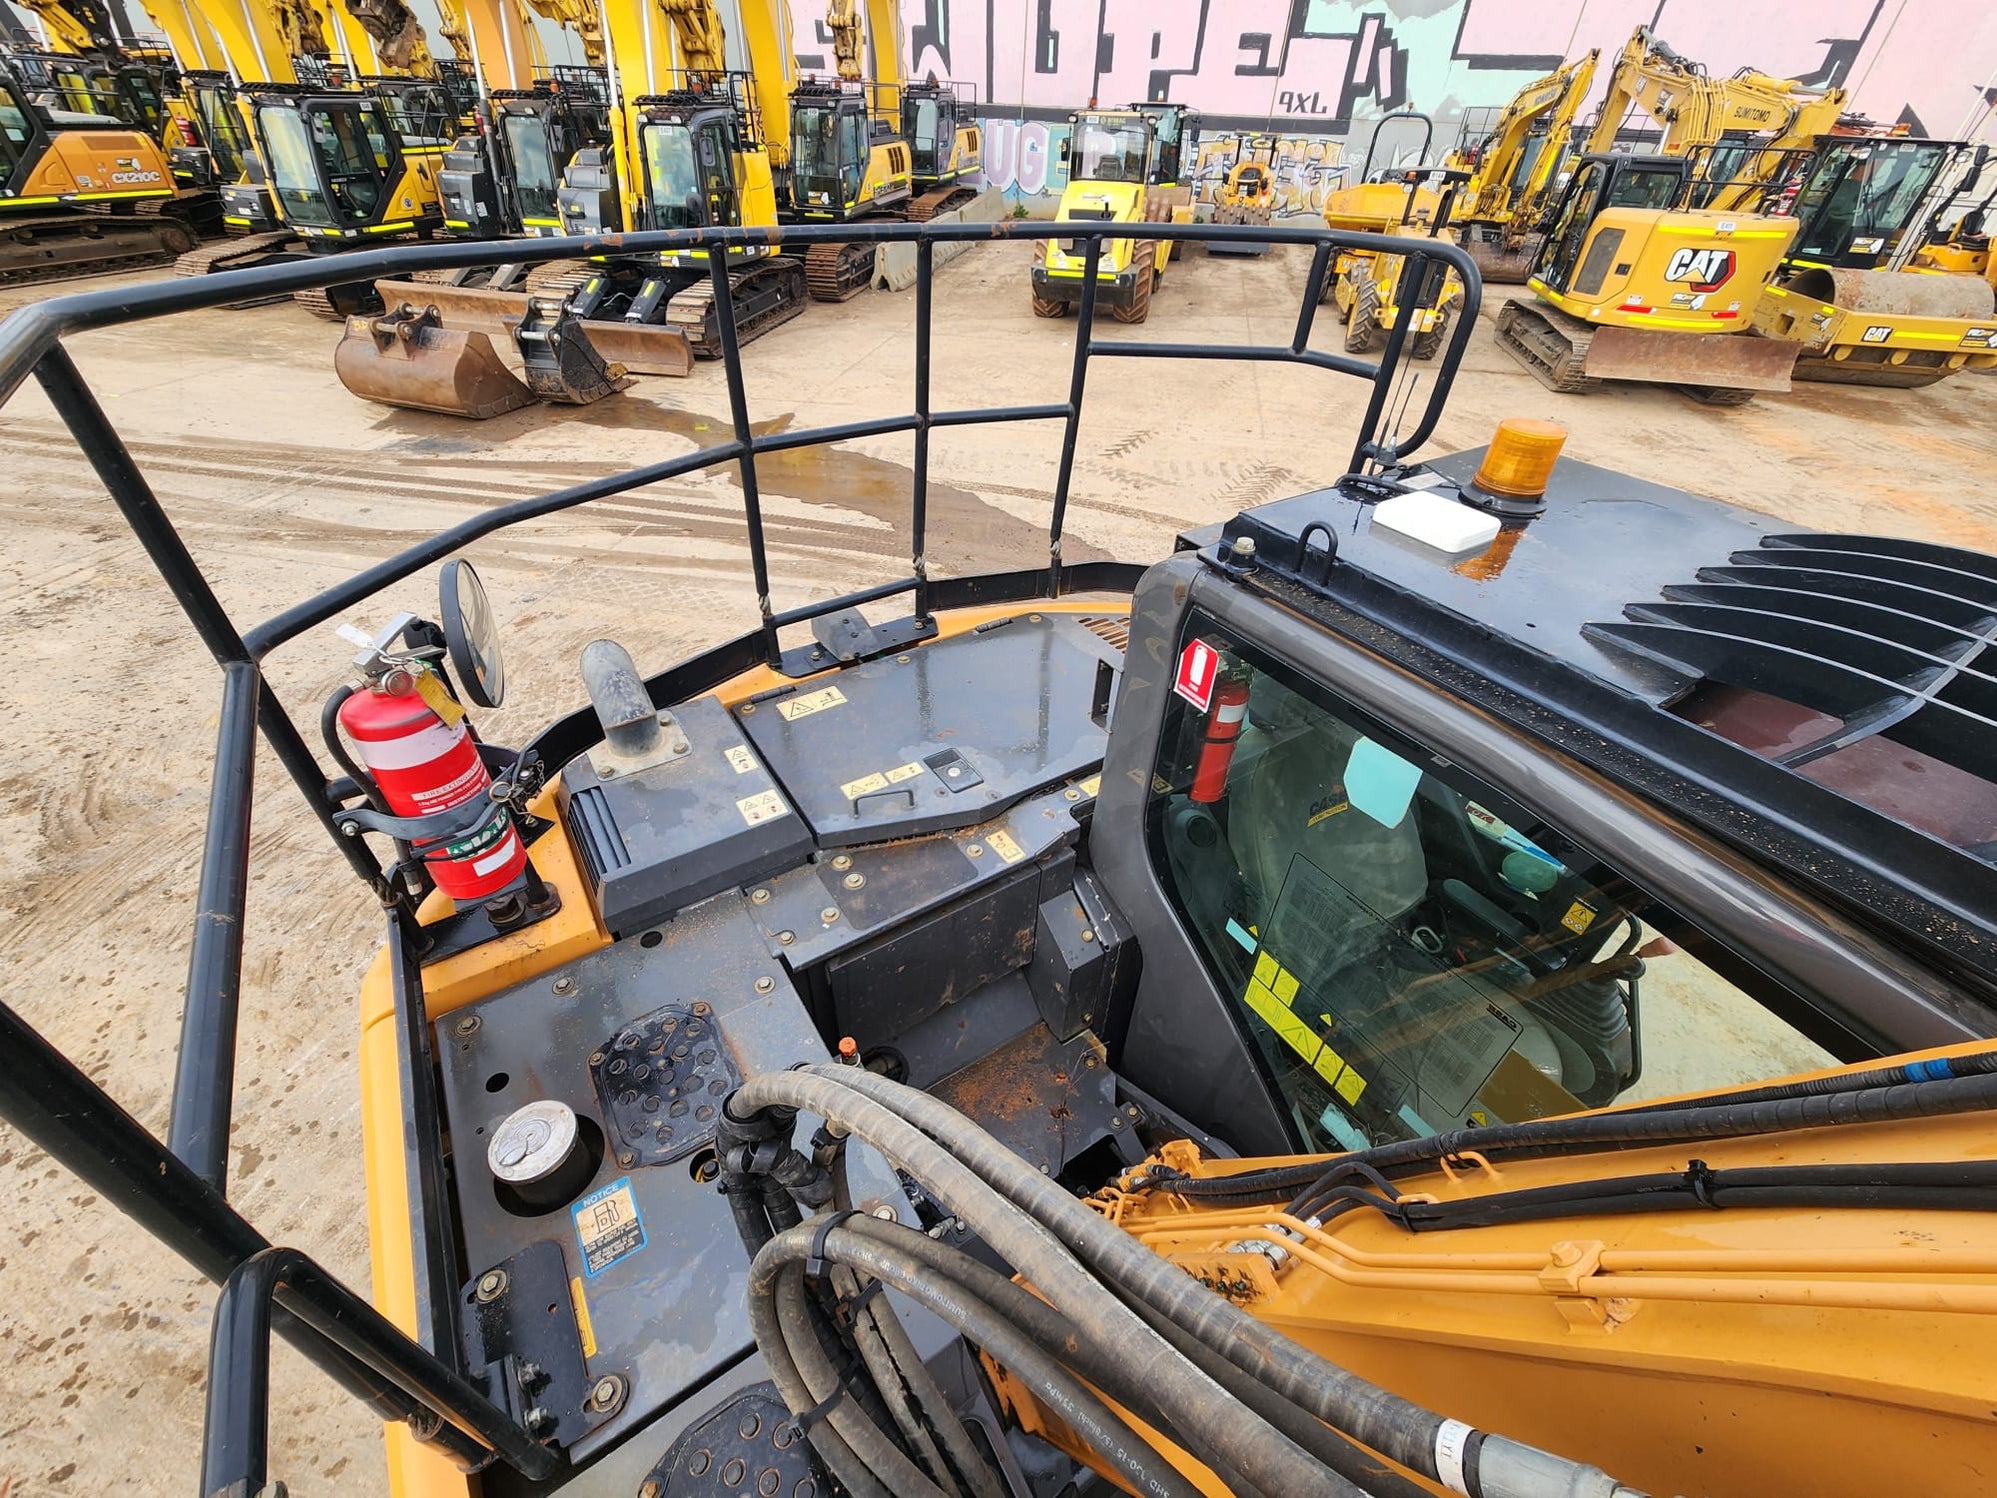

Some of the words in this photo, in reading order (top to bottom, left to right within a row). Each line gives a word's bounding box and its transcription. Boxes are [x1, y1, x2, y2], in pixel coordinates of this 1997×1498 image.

[1734, 106, 1771, 122] SUMITOMO
[1664, 248, 1730, 284] CAT
[1863, 326, 1892, 342] CAT
[582, 1184, 619, 1208] NOTICE
